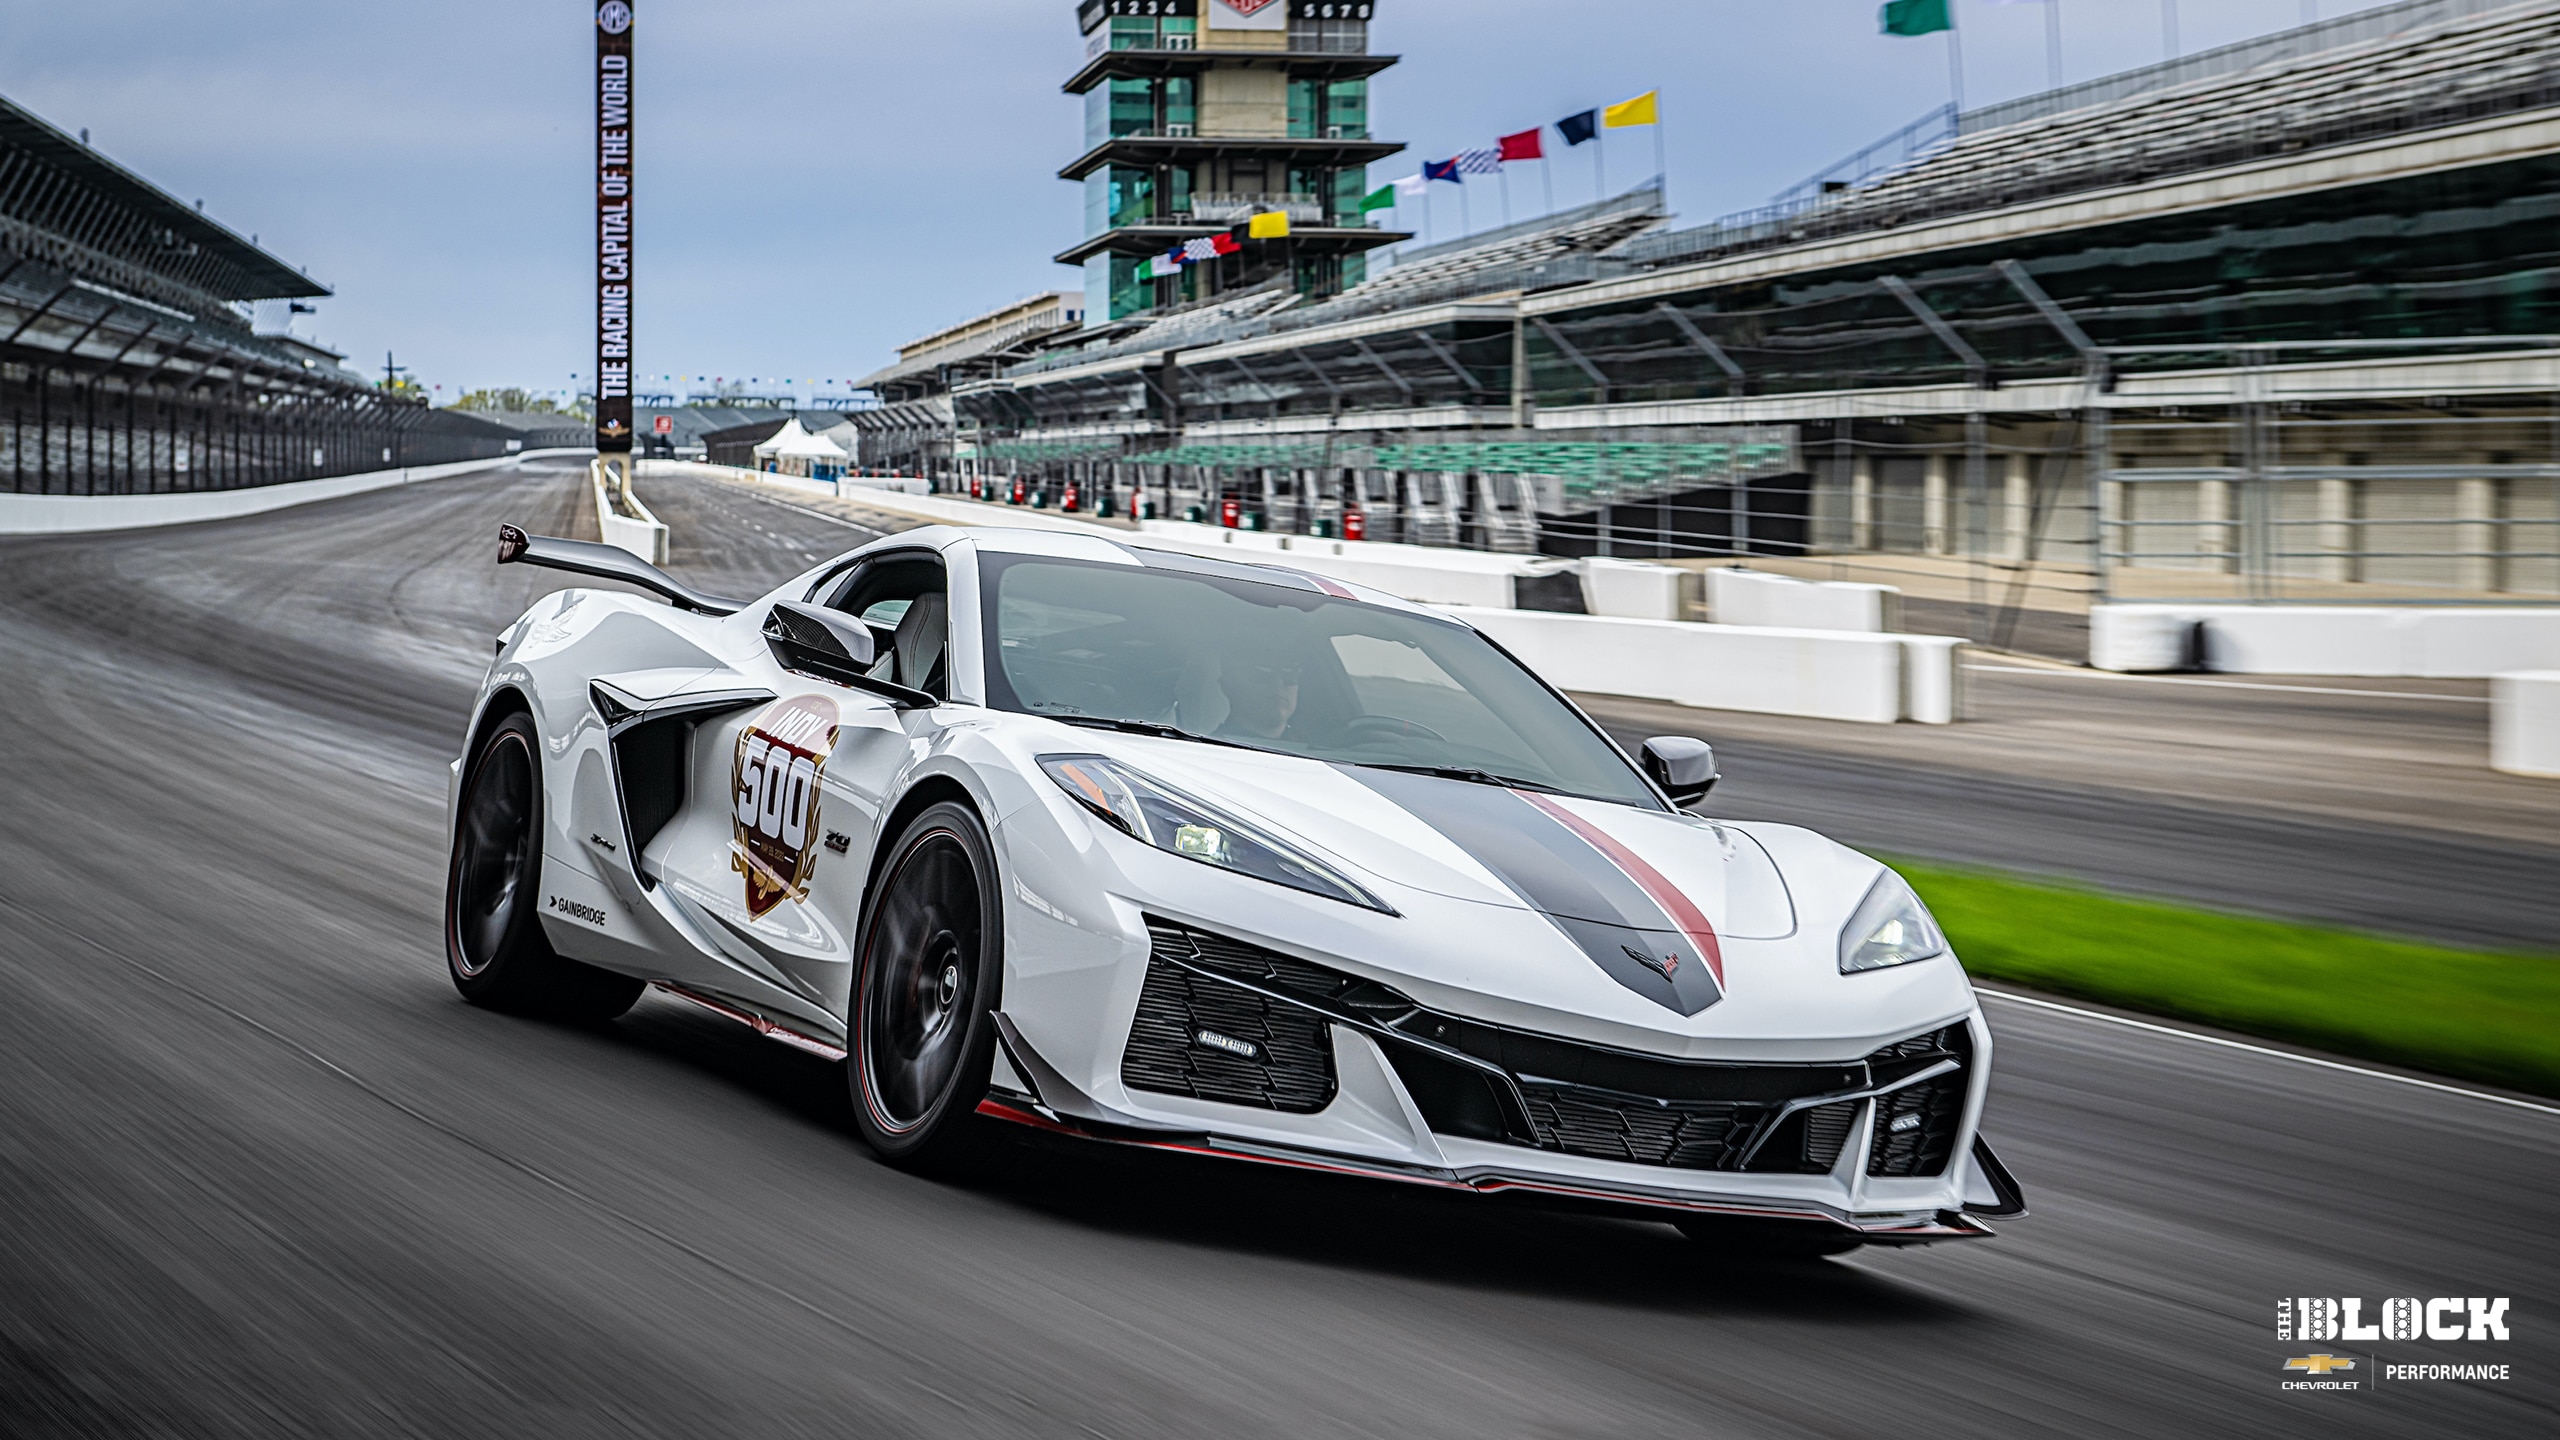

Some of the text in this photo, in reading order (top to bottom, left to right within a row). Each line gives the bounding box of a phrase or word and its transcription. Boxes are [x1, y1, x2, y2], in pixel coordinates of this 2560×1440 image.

[1111, 1, 1176, 15] 1 2 3 4
[1304, 3, 1370, 18] 5 6 7 8
[601, 55, 628, 400] THE RACING CAPITAL OF THE WORLD
[766, 706, 828, 748] INDY
[738, 735, 816, 851] 500
[558, 897, 606, 926] GAINBRIDGE
